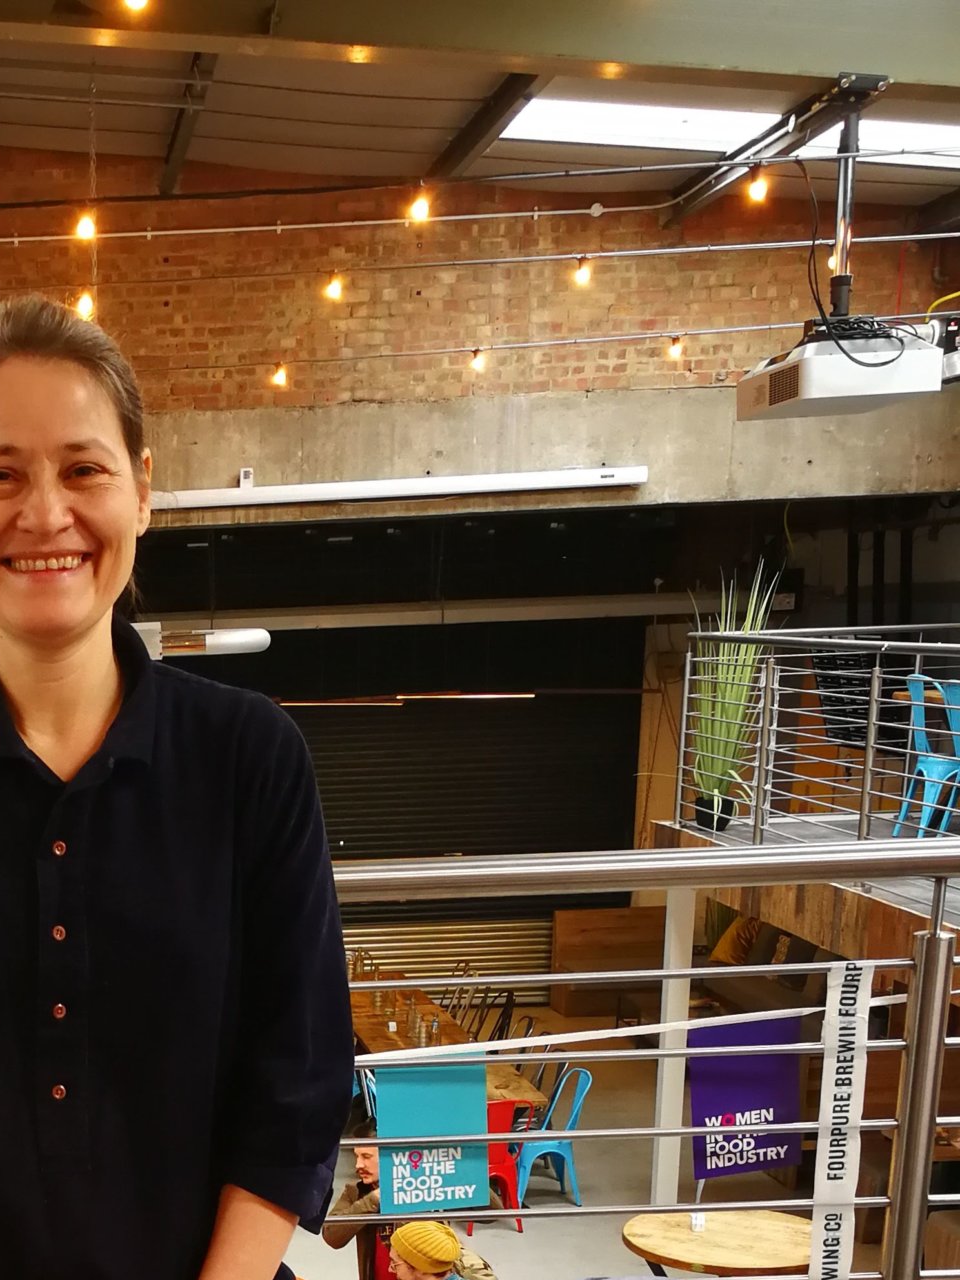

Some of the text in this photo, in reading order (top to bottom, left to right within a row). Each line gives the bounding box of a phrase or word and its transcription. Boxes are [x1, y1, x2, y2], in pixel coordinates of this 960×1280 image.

[839, 962, 864, 1017] FOURP
[827, 1025, 857, 1181] FOURPURE BREWIN
[705, 1108, 774, 1127] WOMEN
[392, 1147, 462, 1166] WOMEN
[706, 1138, 755, 1156] FOOD
[707, 1145, 788, 1170] INDUSTRY
[393, 1161, 455, 1178] IN THE
[393, 1175, 443, 1192] FOOD
[393, 1185, 476, 1205] INDUSTRY
